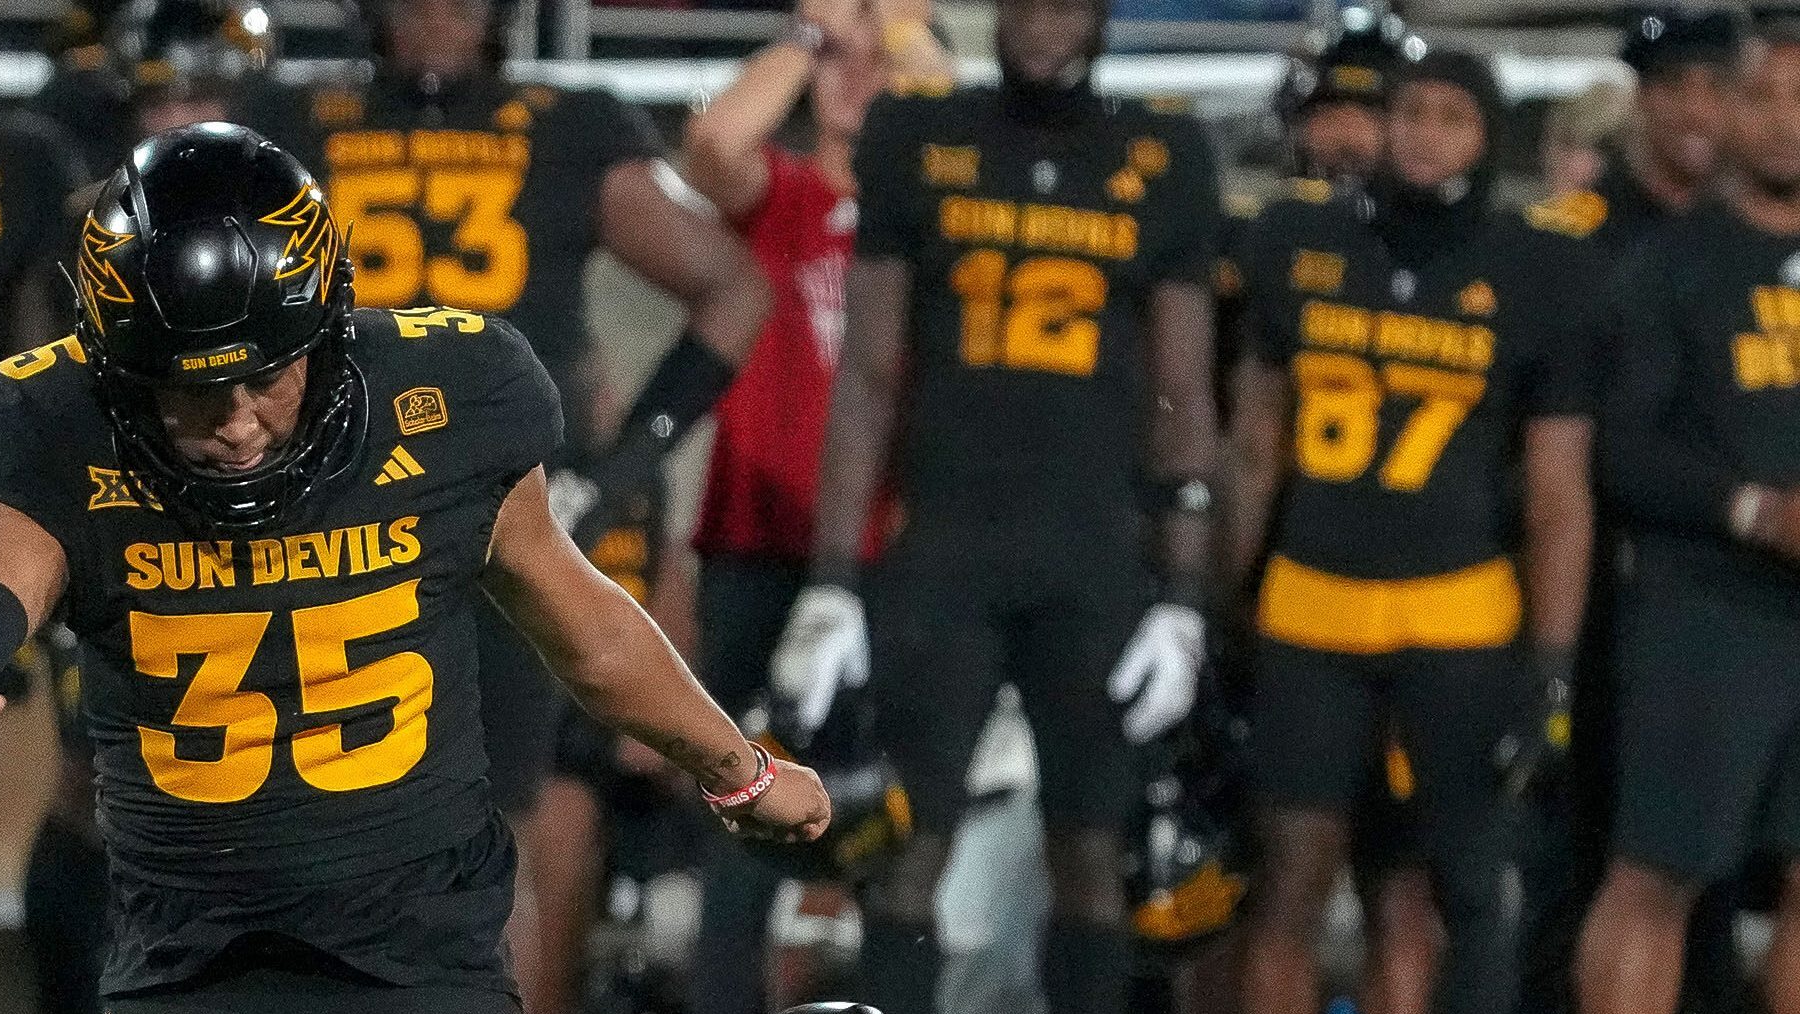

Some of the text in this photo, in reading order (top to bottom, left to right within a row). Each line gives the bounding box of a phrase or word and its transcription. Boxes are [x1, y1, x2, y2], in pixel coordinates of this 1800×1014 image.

[330, 172, 529, 311] 53
[182, 348, 248, 371] SUN DEVILS
[388, 305, 486, 339] 3
[951, 249, 1107, 375] 12
[1293, 354, 1486, 491] 87
[123, 515, 422, 591] SUN DEVILS
[128, 577, 434, 804] 35
